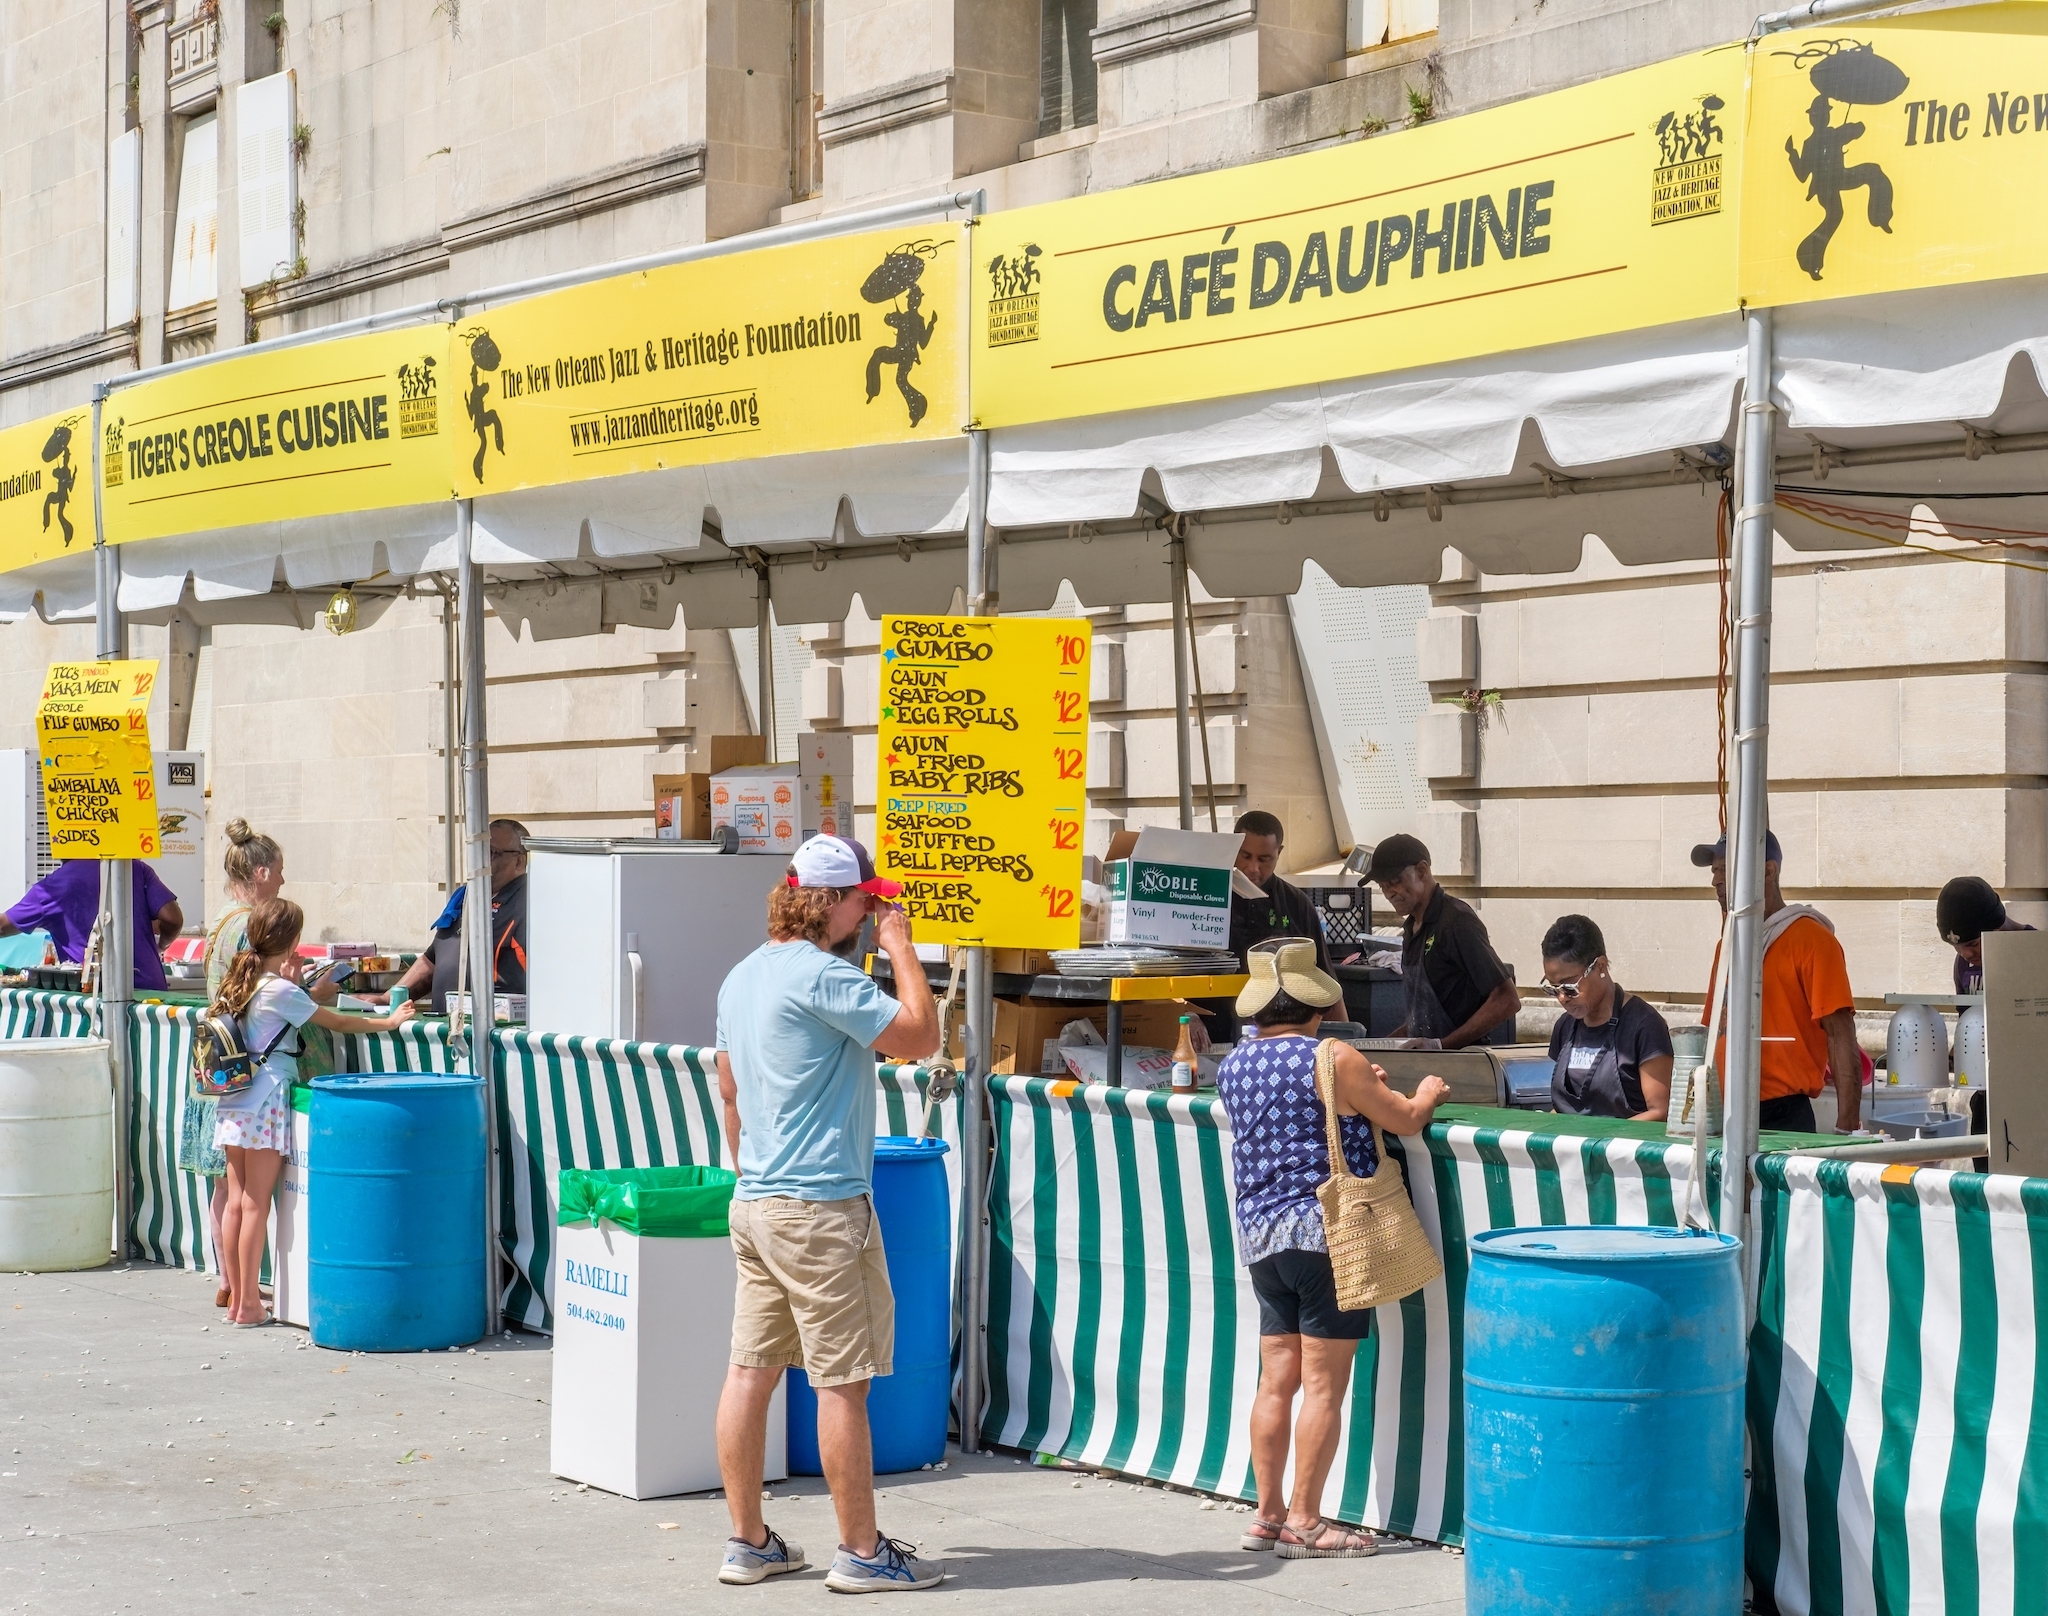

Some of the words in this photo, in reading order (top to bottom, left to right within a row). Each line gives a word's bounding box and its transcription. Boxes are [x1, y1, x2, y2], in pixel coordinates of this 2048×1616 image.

[1905, 98, 1970, 146] The
[1655, 169, 1673, 187] NEW
[1678, 159, 1720, 181] ORLEANS
[1654, 186, 1672, 204] JAZZ
[1673, 186, 1679, 199] &
[1680, 176, 1720, 197] HERITAGE
[1653, 197, 1703, 220] FOUNDATION,
[1704, 194, 1720, 210] INC.
[1102, 225, 1238, 333] CAFÉ
[1249, 180, 1554, 310] DAUPHINE
[990, 303, 1004, 315] NEW
[1006, 296, 1038, 312] ORLEANS
[990, 316, 1002, 330] JAZZ
[1010, 310, 1038, 326] HERITAGE
[990, 327, 1026, 343] FOUNDATION,
[1027, 324, 1038, 337] INC.
[501, 369, 523, 400] The
[526, 363, 551, 396] New
[555, 353, 606, 389] Orleans
[610, 347, 640, 384] Jazz
[644, 340, 658, 371] &
[662, 329, 740, 370] Heritage
[744, 311, 862, 356] Foundation
[570, 393, 760, 449] www.jazzandheritage.org
[128, 433, 191, 480] TIGER'S
[193, 413, 273, 467] CREOLE
[276, 395, 388, 453] CUISINE
[896, 638, 994, 662] GUMBO
[1055, 634, 1086, 666] $10
[50, 681, 82, 697] YAKA
[83, 679, 122, 695] MEIN
[82, 667, 110, 677] FAMOUS
[134, 672, 153, 696] $12
[890, 669, 948, 688] CAJUN
[126, 708, 145, 731] $12
[896, 706, 940, 725] EGG
[943, 705, 1019, 731] ROLLS
[1052, 690, 1083, 724] $12
[72, 716, 120, 732] GUMBO
[891, 735, 949, 756] CAJUN
[172, 765, 192, 777] MQ
[1053, 747, 1084, 780] $12
[48, 778, 122, 796] JAMBALAYA
[889, 769, 959, 793] BABY
[963, 769, 1024, 798] RIBS
[887, 798, 924, 813] DEEP
[927, 800, 968, 816] FRIED
[58, 829, 100, 846] SIDES
[140, 833, 154, 854] $6
[1048, 818, 1080, 850] $12
[1144, 875, 1198, 892] NOBLE
[898, 880, 982, 906] MPLER
[1038, 884, 1075, 919] $12
[1170, 892, 1202, 900] Disposable
[1204, 894, 1225, 902] Gloves
[1132, 907, 1156, 919] Vinyl
[1172, 910, 1224, 923] Powder-Free
[1191, 922, 1224, 936] X-Large
[565, 1258, 628, 1298] RAMELLI
[566, 1302, 625, 1332] 504.482.2040
